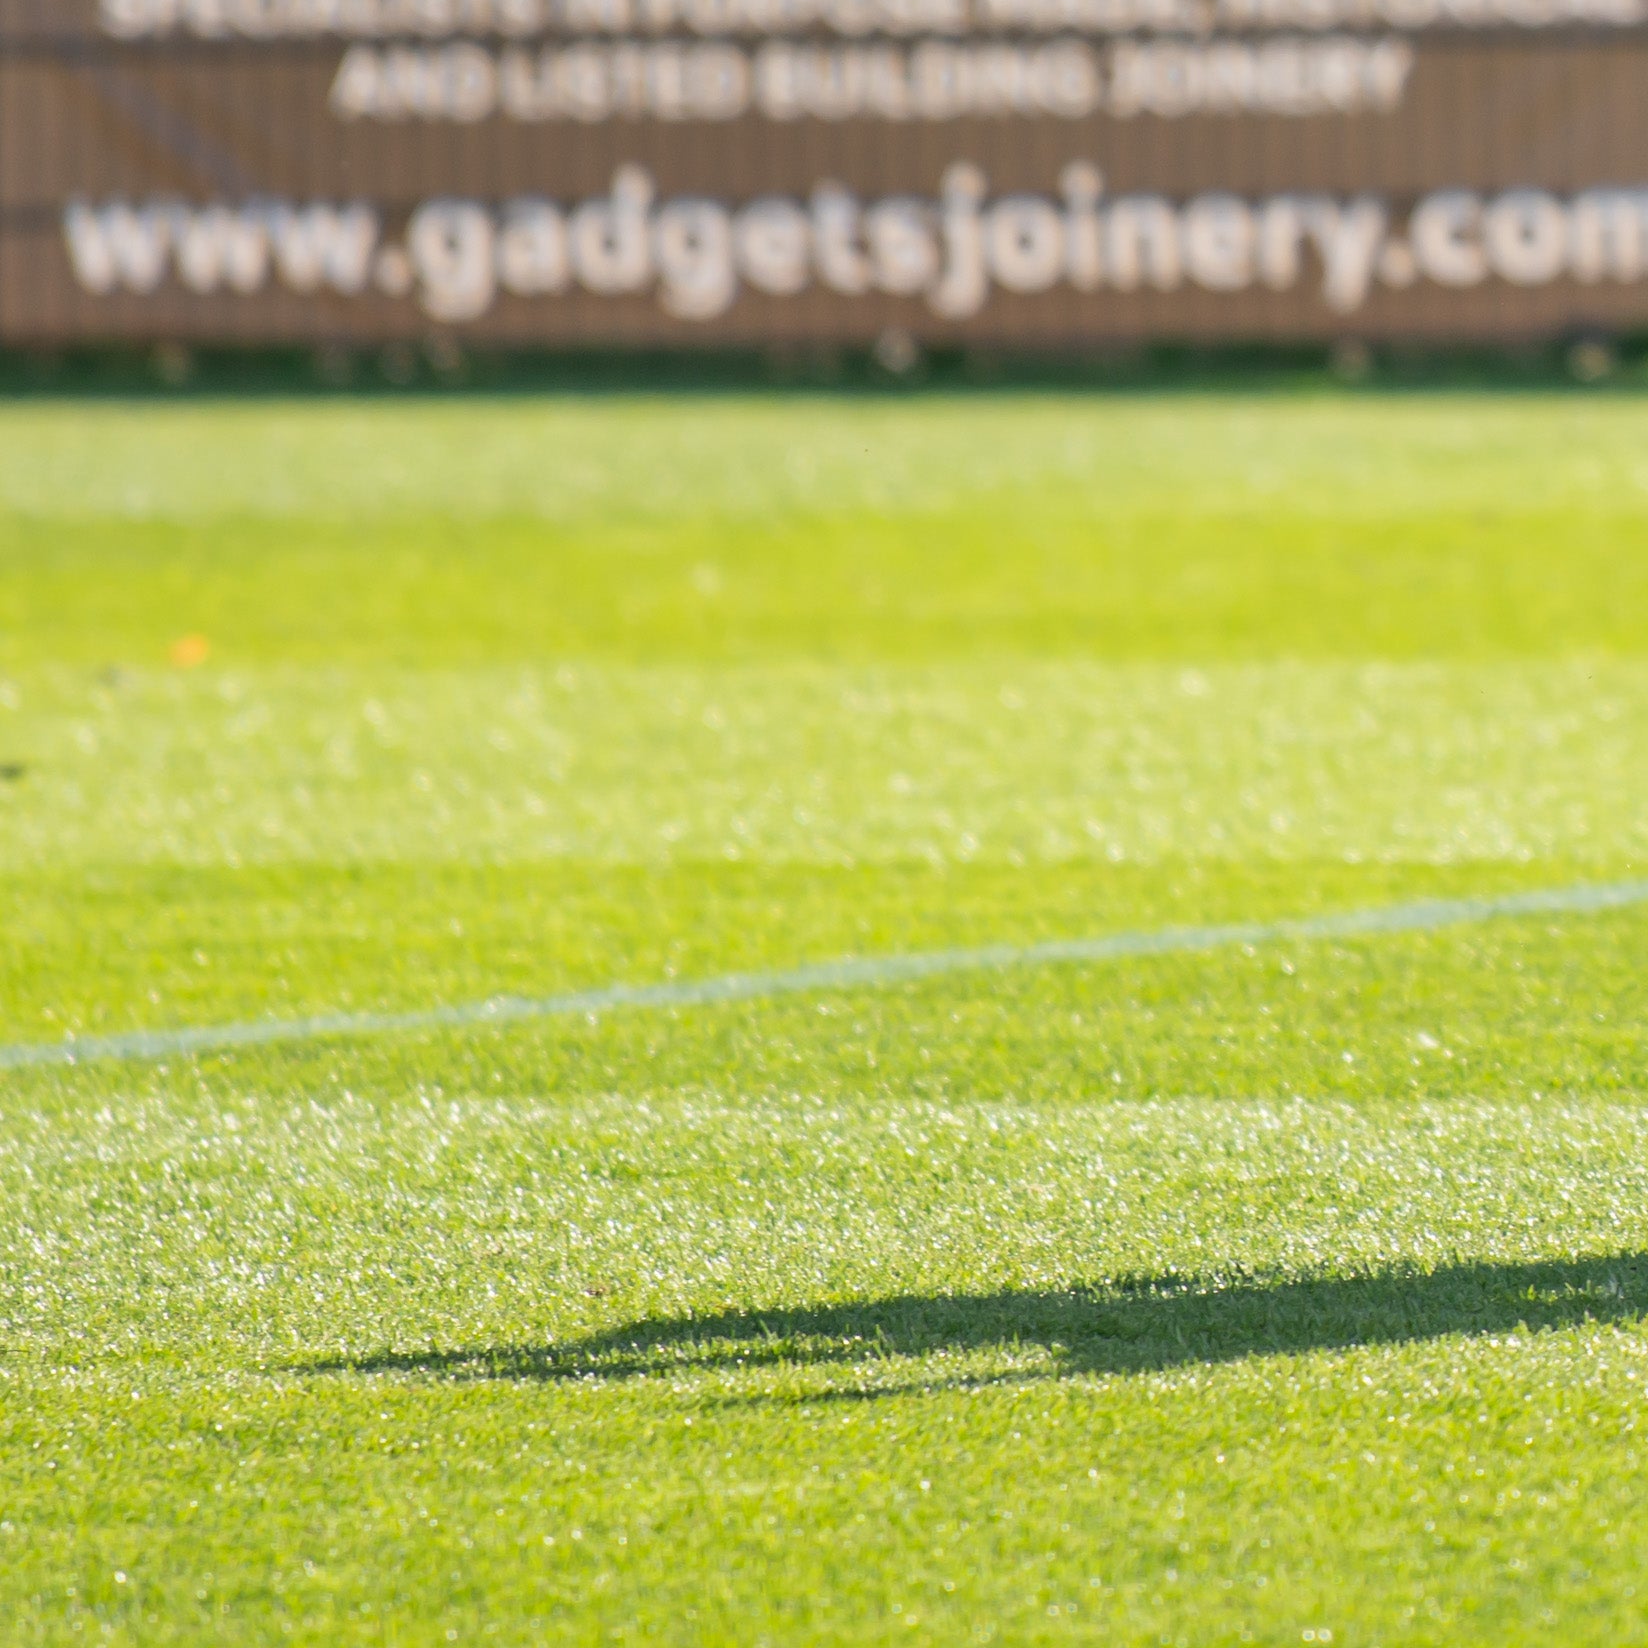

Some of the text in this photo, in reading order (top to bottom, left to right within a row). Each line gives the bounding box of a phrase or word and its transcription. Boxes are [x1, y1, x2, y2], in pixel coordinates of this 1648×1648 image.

[330, 38, 1412, 120] AND LISTED BUILDING JOINERY
